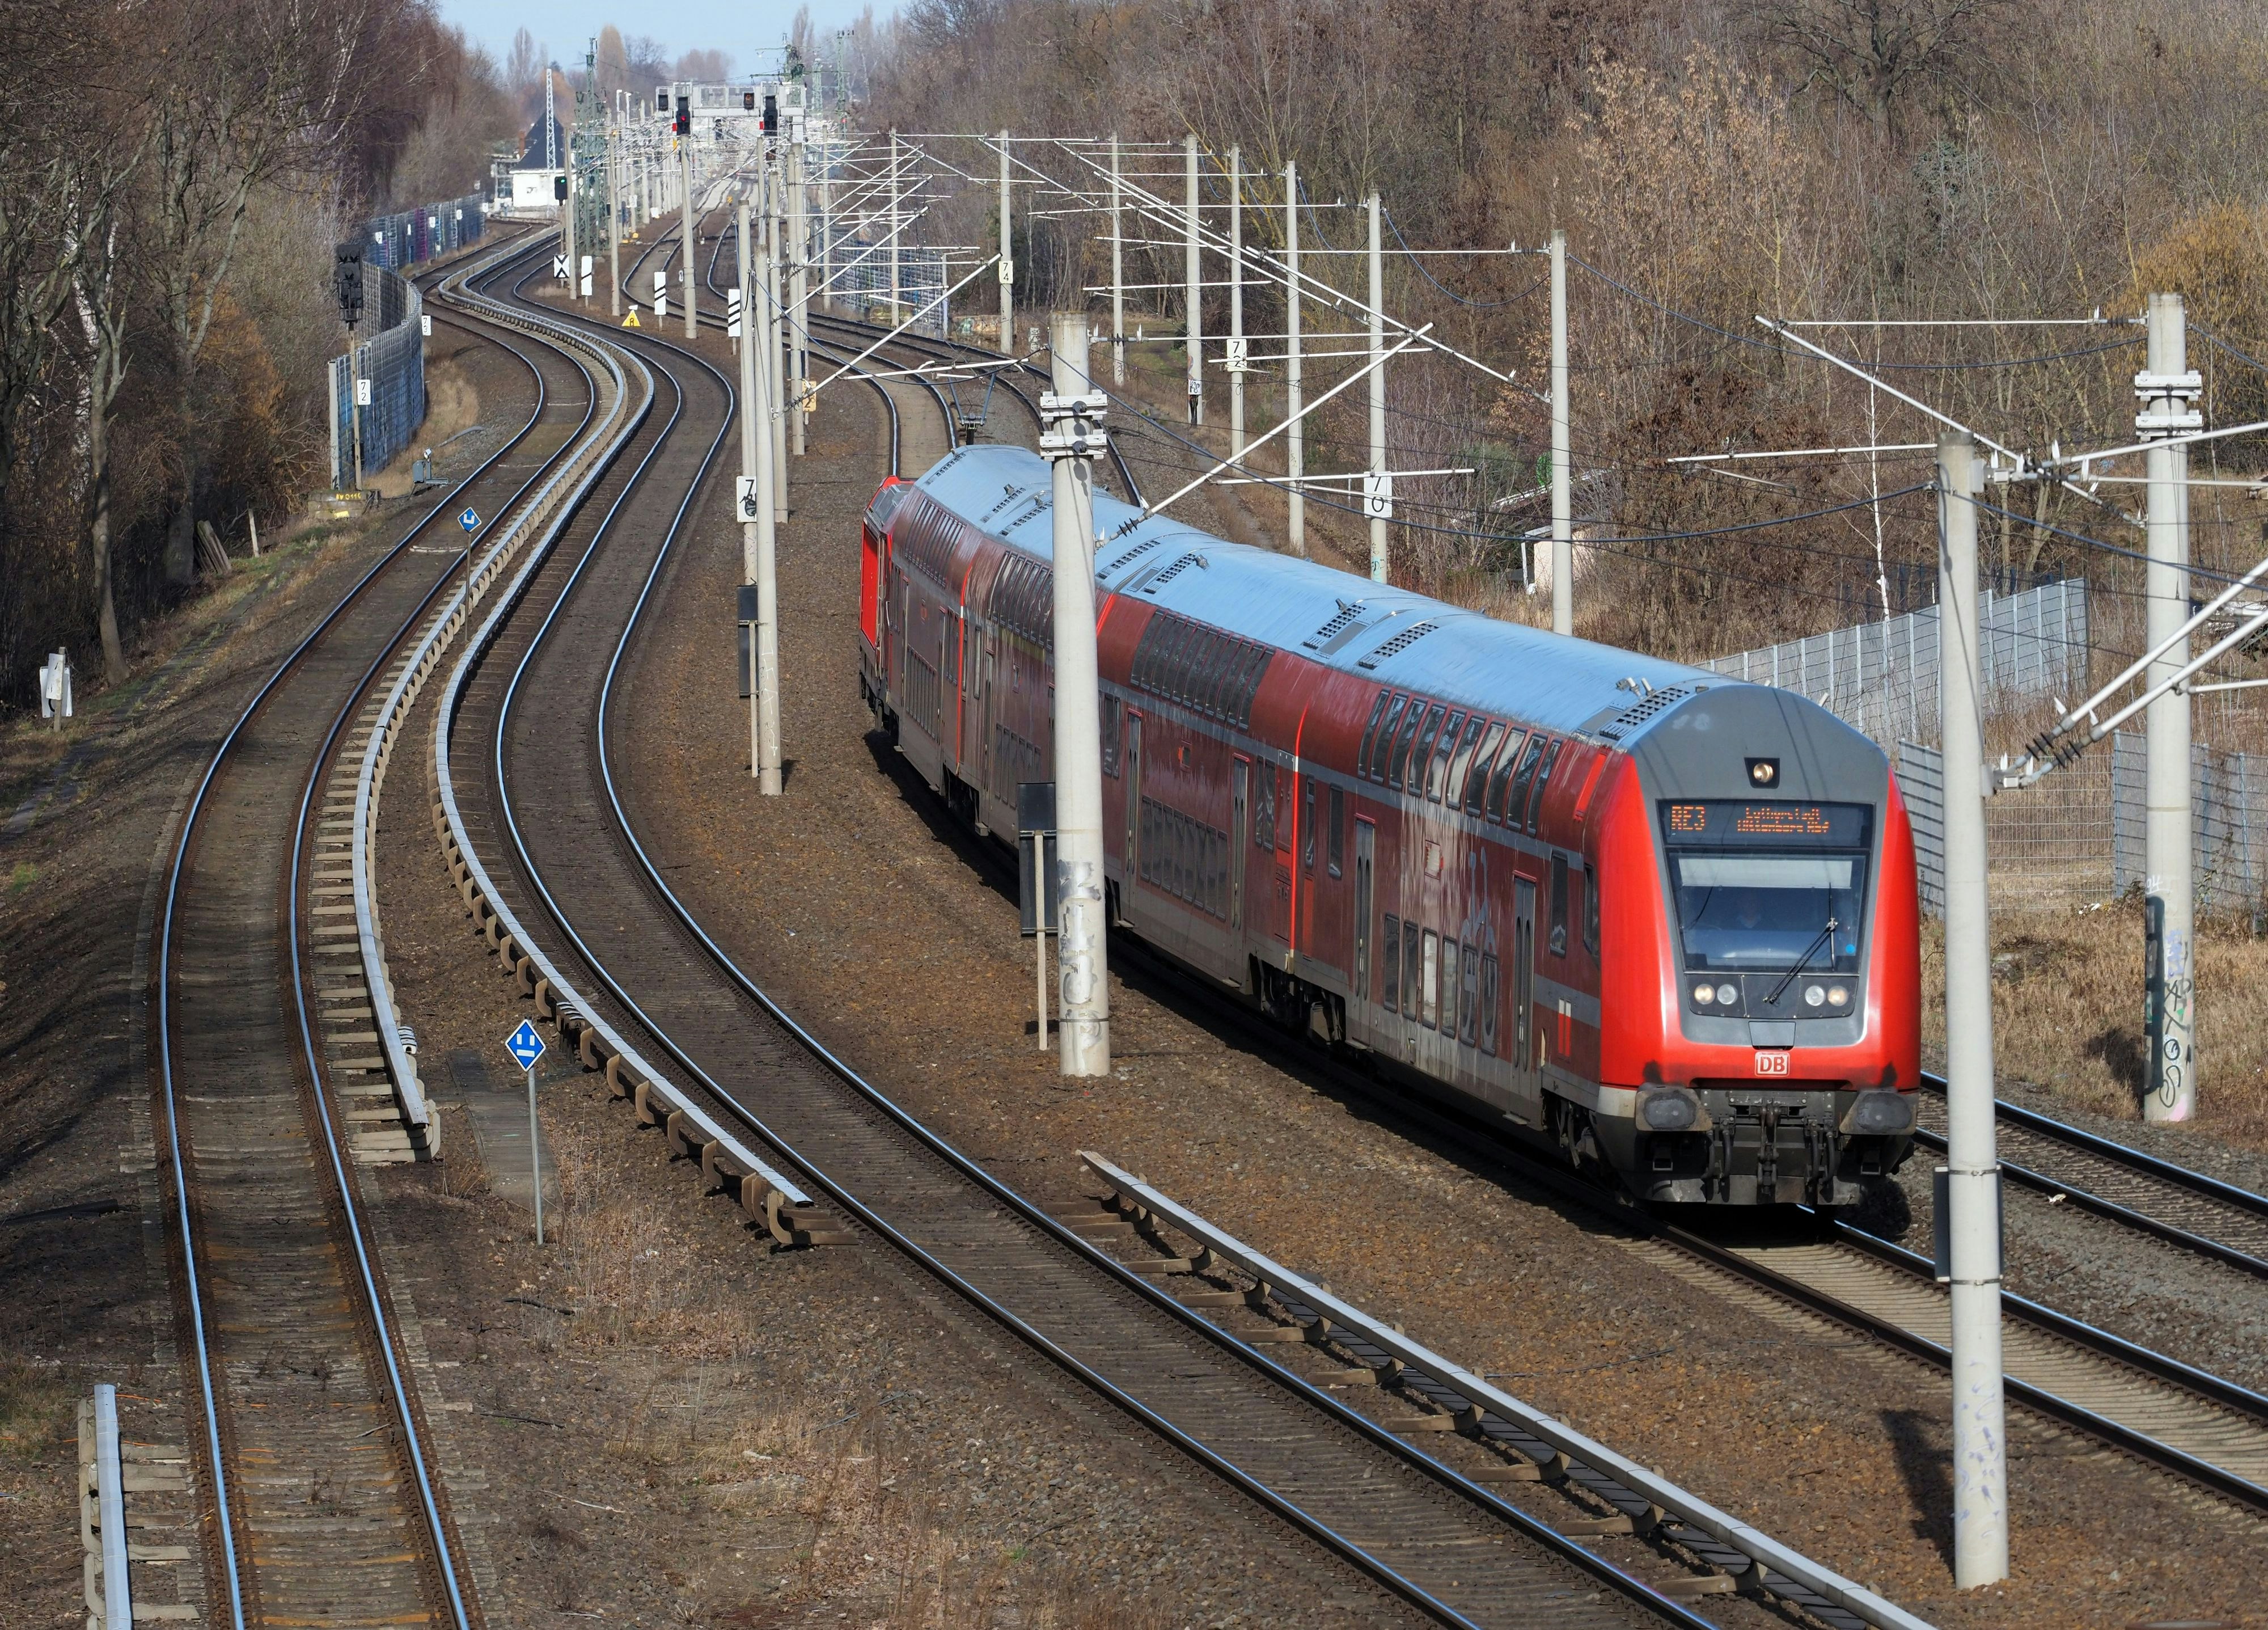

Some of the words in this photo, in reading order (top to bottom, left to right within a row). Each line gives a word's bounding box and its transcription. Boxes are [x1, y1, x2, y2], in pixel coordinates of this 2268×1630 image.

[1003, 263, 1008, 271] 7
[1233, 341, 1239, 353] 7
[361, 382, 366, 391] 7
[361, 392, 366, 401] 2
[1672, 806, 1705, 830] RE3
[1759, 1056, 1785, 1072] DB
